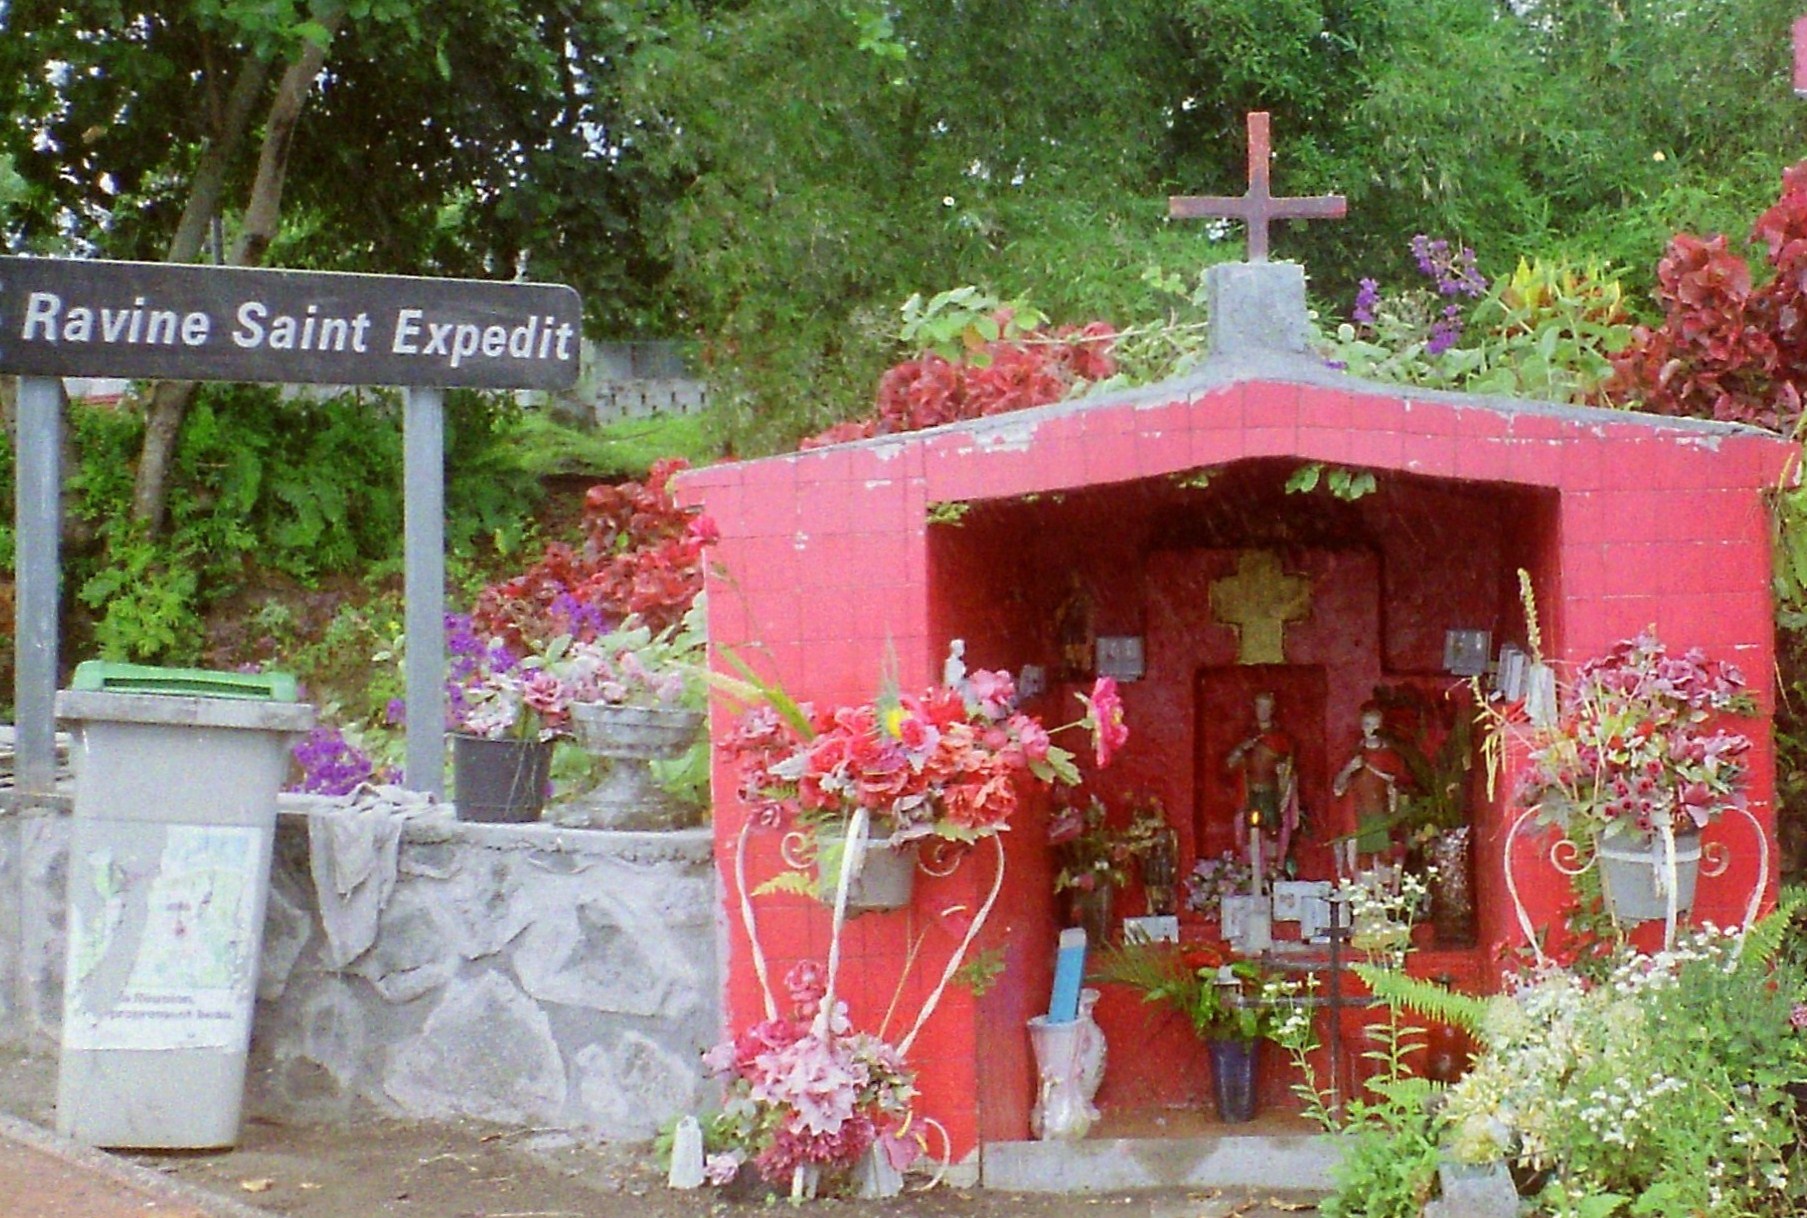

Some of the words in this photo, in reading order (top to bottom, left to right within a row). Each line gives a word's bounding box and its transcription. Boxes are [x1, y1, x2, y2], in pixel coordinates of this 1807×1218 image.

[22, 292, 209, 345] Ravine
[232, 302, 370, 353] Saint
[392, 309, 573, 368] Expedit
